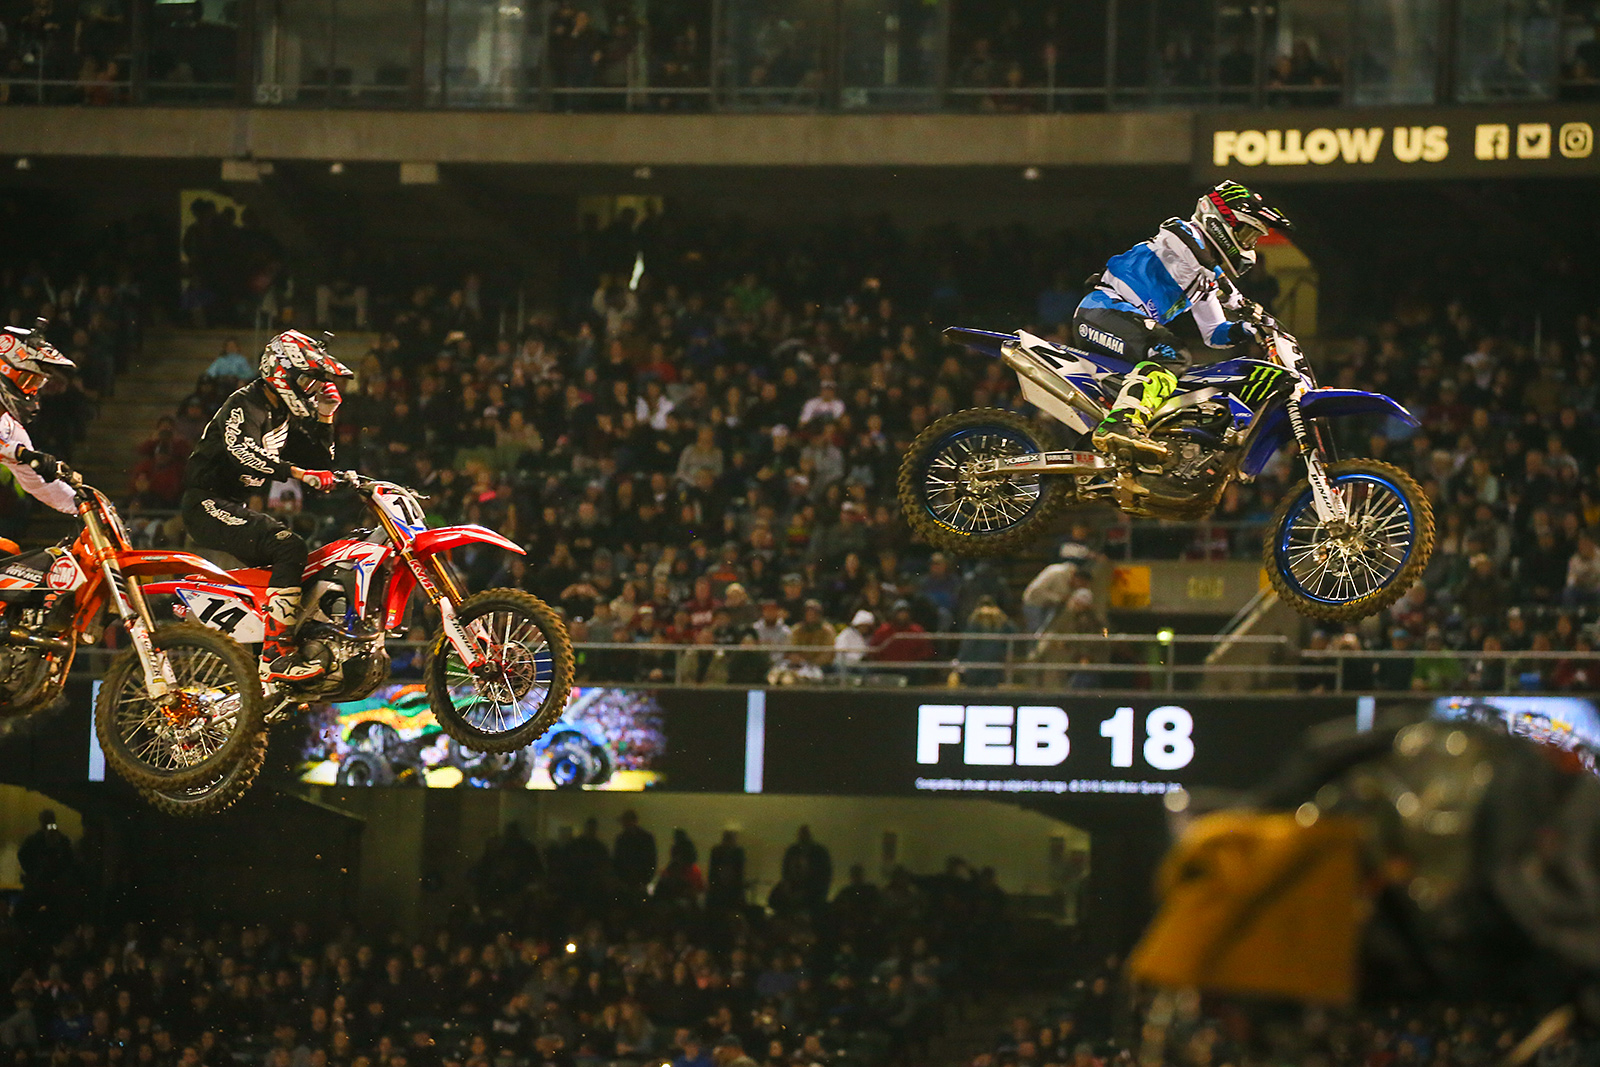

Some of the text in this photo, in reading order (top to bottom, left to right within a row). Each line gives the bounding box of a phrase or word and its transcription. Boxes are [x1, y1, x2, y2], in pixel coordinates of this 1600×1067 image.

[1213, 126, 1449, 166] FOLLOW US
[1087, 327, 1125, 355] YAMAHA
[1286, 400, 1306, 440] YAMAHA
[1311, 473, 1336, 517] DUNLOP
[199, 597, 248, 633] 14
[916, 704, 1195, 770] FEB 18
